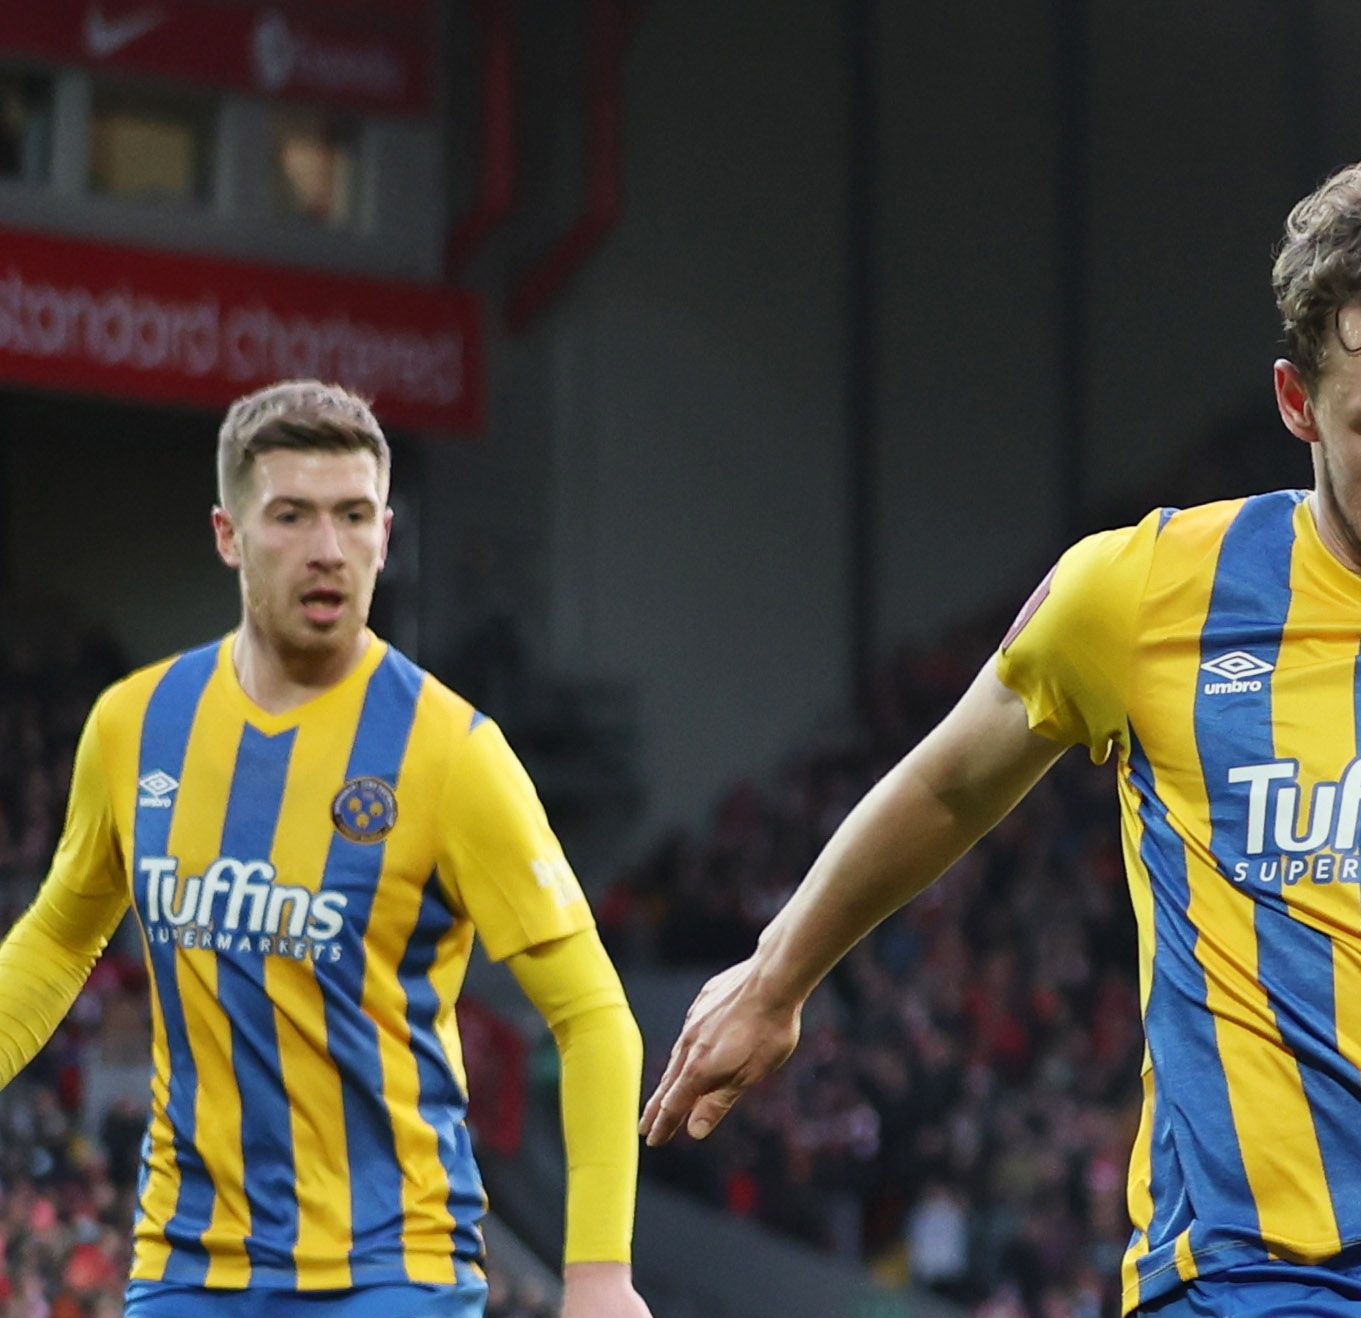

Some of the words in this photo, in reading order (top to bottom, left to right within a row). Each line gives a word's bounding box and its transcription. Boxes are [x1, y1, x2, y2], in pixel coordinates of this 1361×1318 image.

[1204, 678, 1262, 694] umbro
[139, 857, 348, 940] Tuffins
[147, 928, 343, 963] SUPERMARKETS
